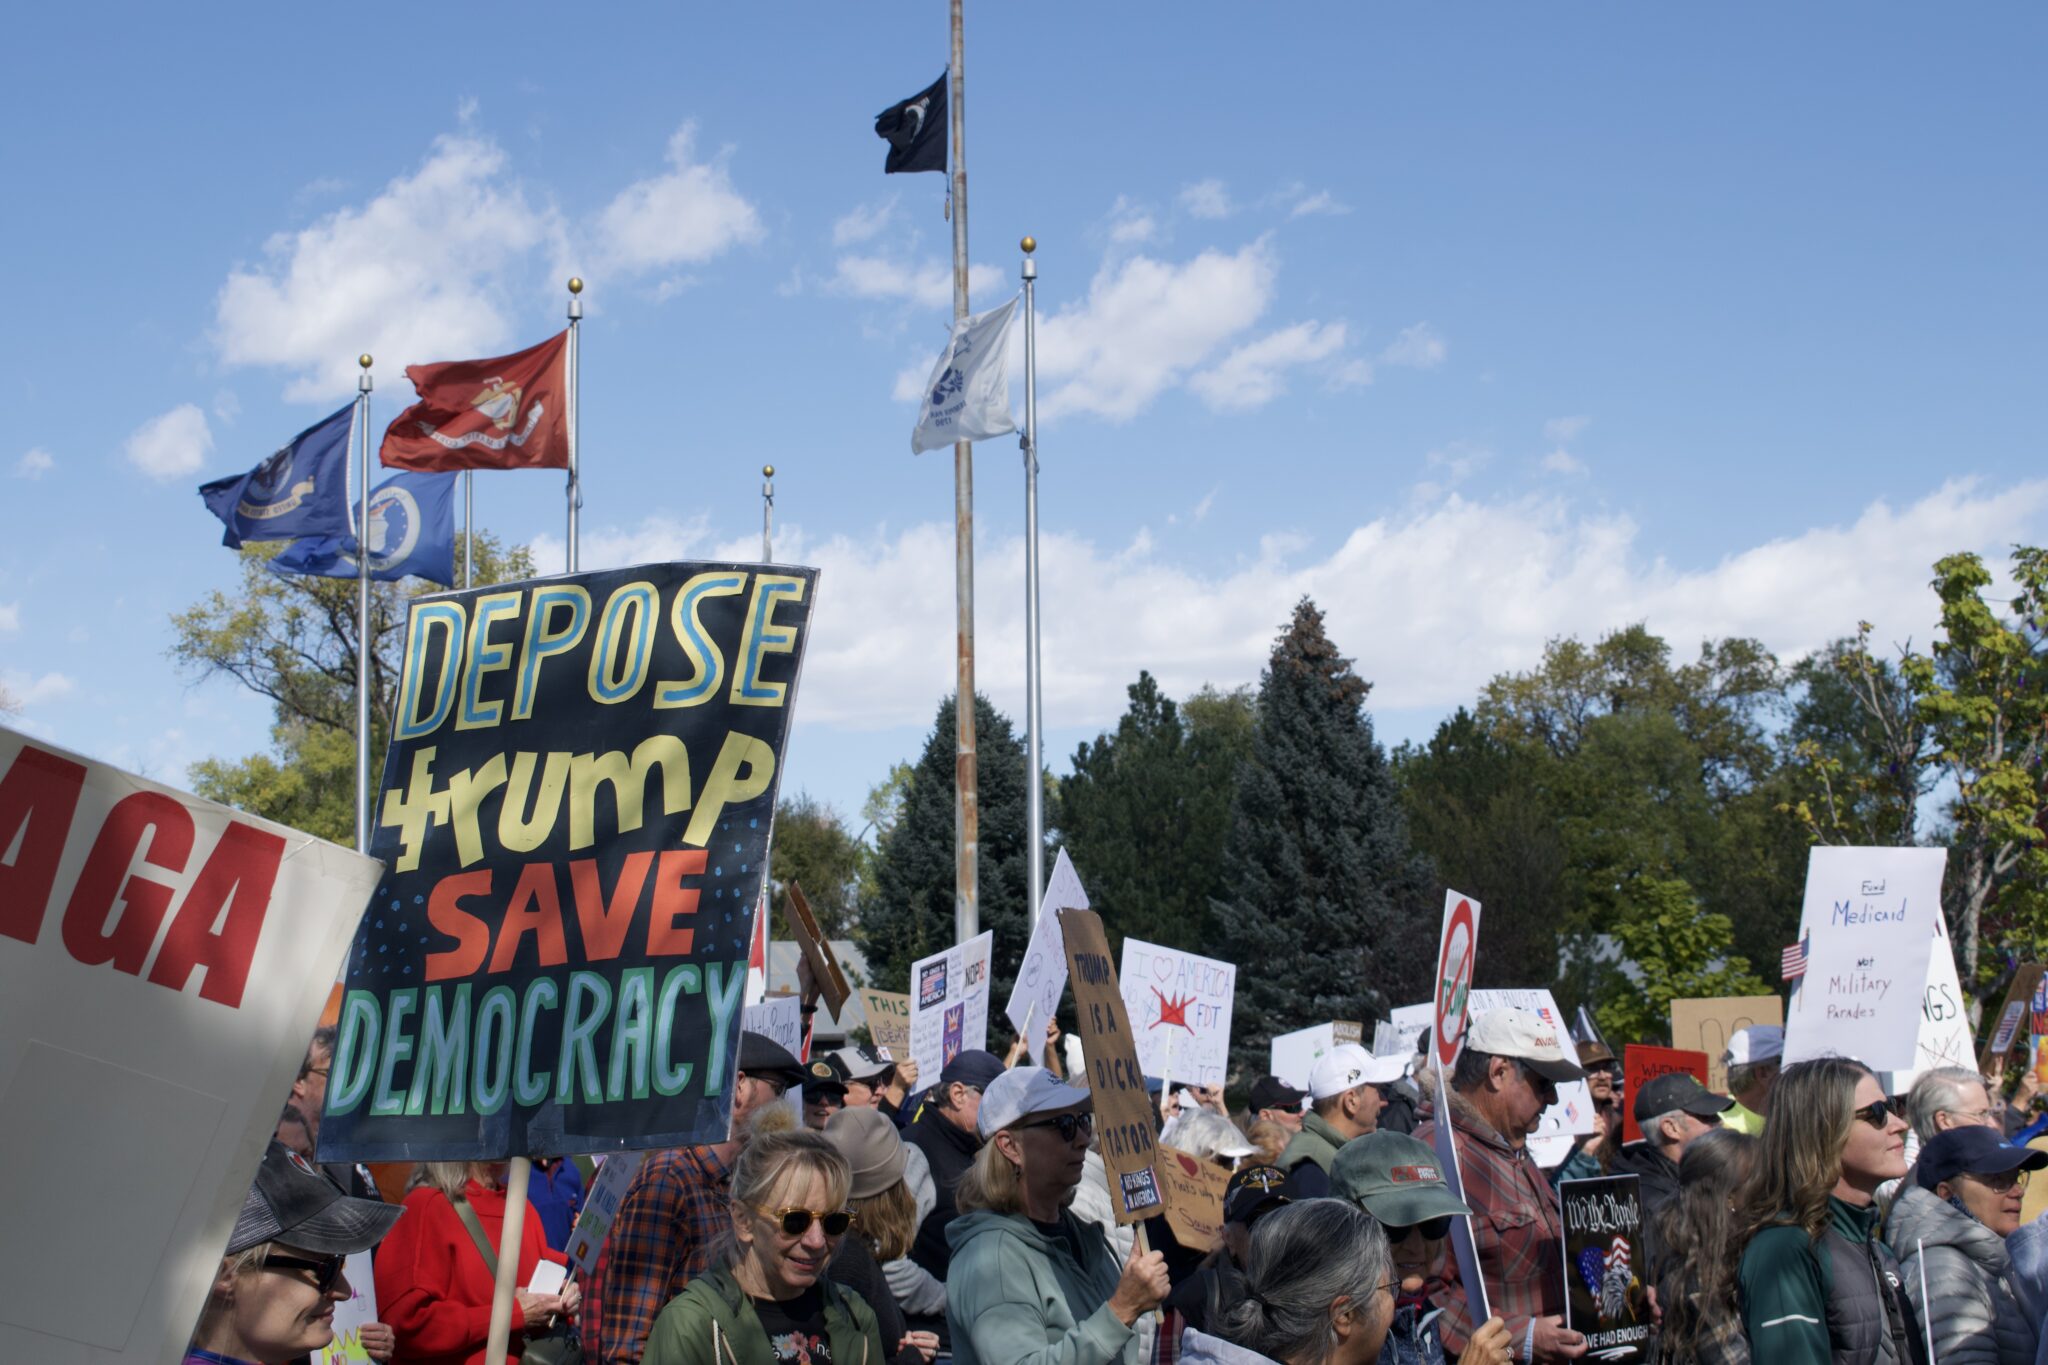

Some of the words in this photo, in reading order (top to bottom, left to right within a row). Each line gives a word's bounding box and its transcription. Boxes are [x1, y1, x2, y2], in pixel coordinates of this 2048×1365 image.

[394, 572, 805, 741] DEPOSE
[424, 850, 709, 981] SAVE
[1074, 952, 1110, 985] TRUMP
[1132, 951, 1150, 979] I
[1176, 957, 1231, 998] AMERICA
[868, 996, 909, 1017] THIS
[921, 988, 945, 1006] AMERICA
[1089, 1002, 1103, 1034] IS
[1106, 1002, 1116, 1033] A
[325, 960, 748, 1116] DEMOCRACY
[1100, 1112, 1157, 1170] (TATOR)
[1134, 1188, 1157, 1206] AMERICA
[1566, 1195, 1588, 1233] We
[1586, 1194, 1606, 1233] the
[1603, 1193, 1641, 1233] People
[1600, 1330, 1616, 1347] HAD
[1616, 1324, 1649, 1344] ENOUGH
